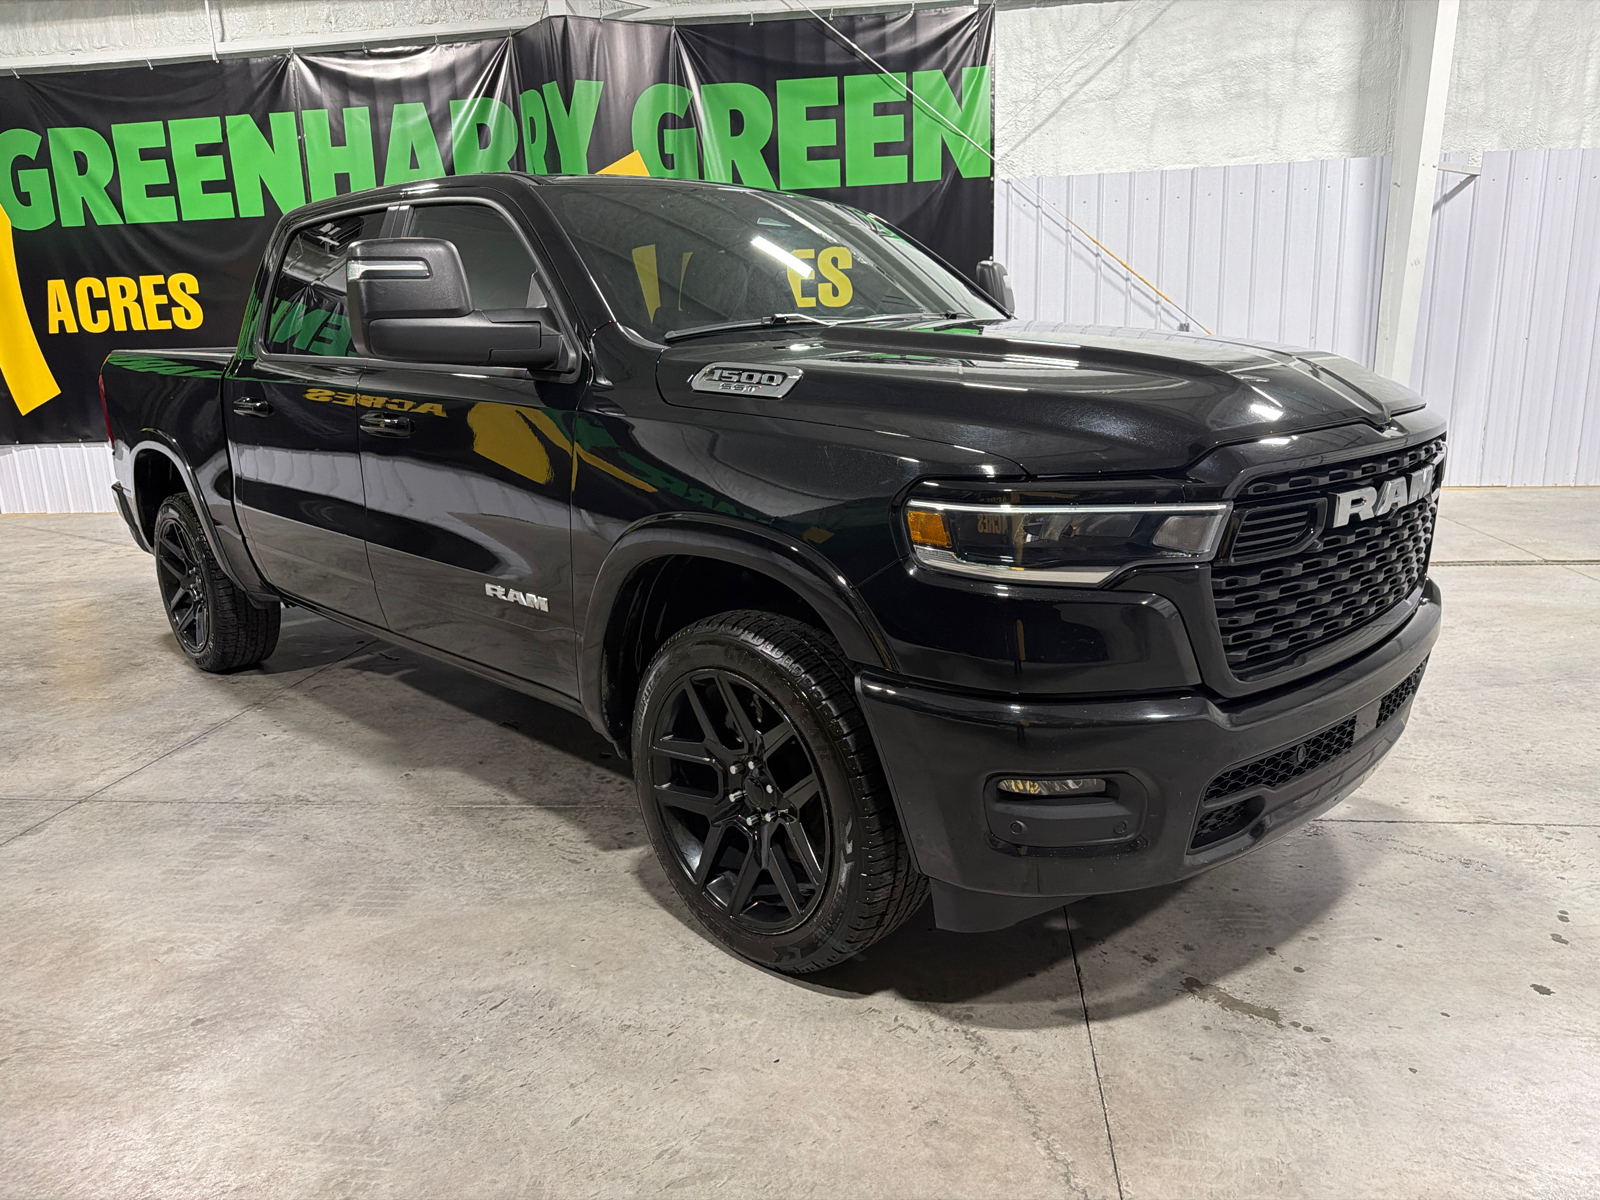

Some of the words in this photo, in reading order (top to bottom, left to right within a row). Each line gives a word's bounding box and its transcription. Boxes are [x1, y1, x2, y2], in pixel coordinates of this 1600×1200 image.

[302, 79, 604, 202] HARRY
[631, 66, 992, 190] GREEN
[0, 111, 306, 231] GREEN
[47, 272, 204, 334] ACRES
[710, 368, 786, 386] 1500
[1331, 464, 1434, 528] RAM
[485, 582, 549, 612] RAM
